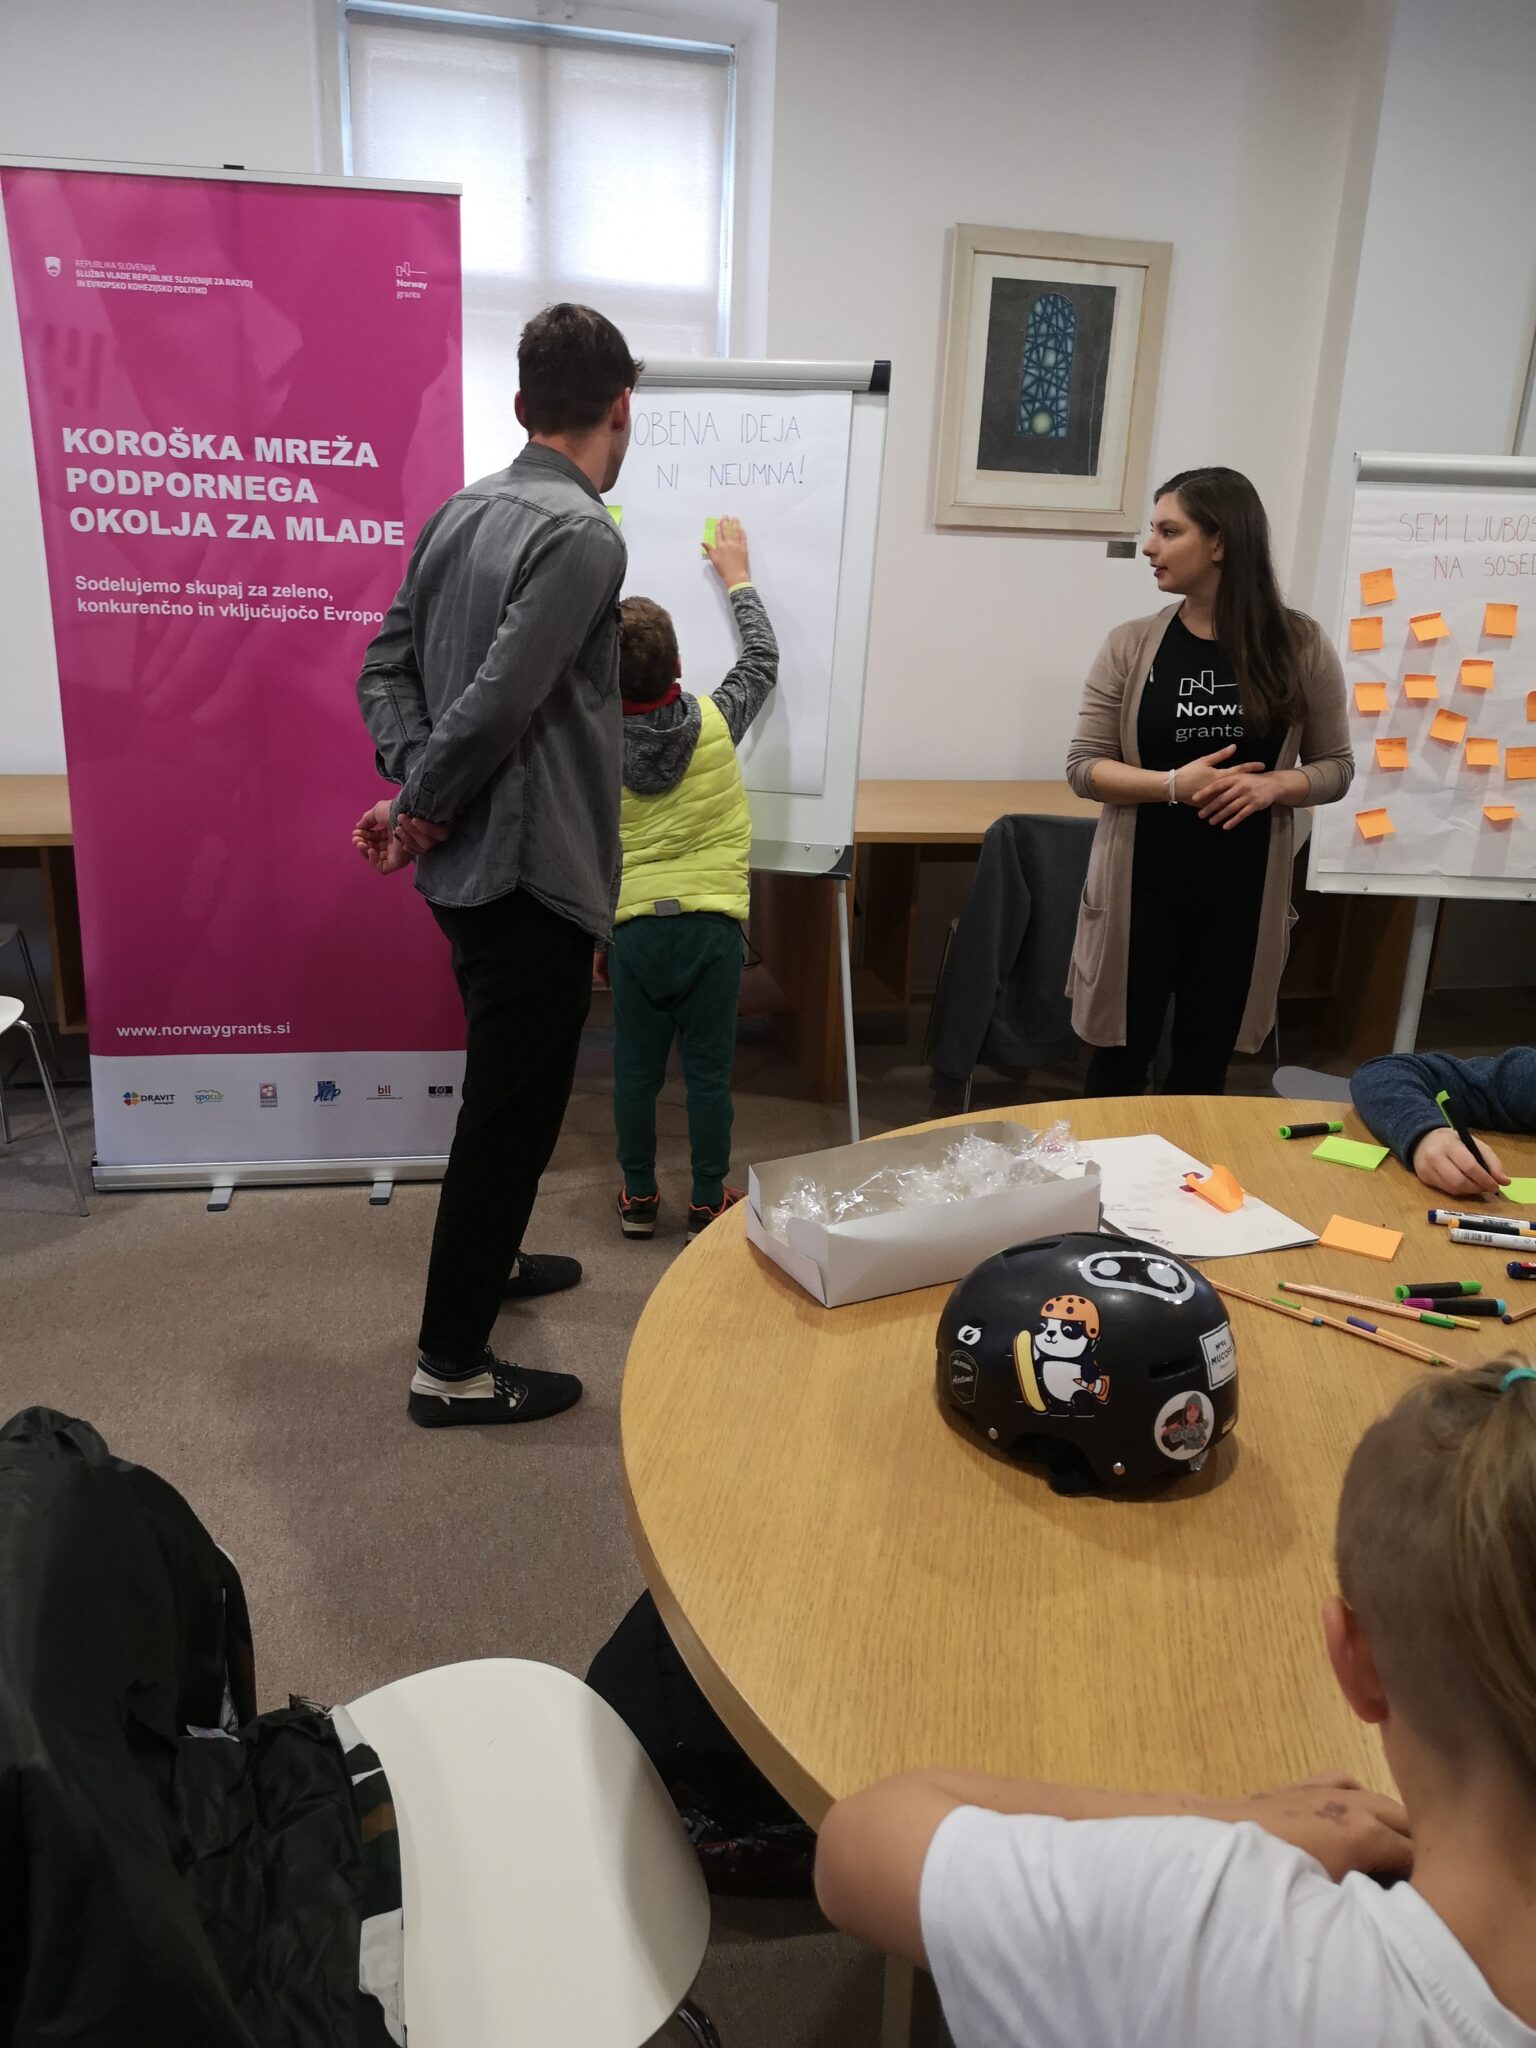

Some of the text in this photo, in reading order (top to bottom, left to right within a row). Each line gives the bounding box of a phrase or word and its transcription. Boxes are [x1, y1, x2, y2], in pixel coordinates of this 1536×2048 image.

[75, 260, 156, 272] REPUBLIKA SLOVENIJA
[76, 269, 253, 288] SLUŽBA VLADE REPUBLIKE SLOVENIJE ZA RAZVOJ
[76, 280, 208, 294] IN EVROPSKO KOHEZIJSKO POLITIKO
[396, 279, 428, 290] Norway
[396, 291, 421, 300] grants
[634, 411, 801, 446] OBENA IDEJA
[62, 427, 379, 468] KOROŠKA MREŽA
[657, 455, 806, 490] NI NEUMNA!
[66, 468, 318, 503] PODPORNEGA
[70, 507, 405, 546] OKOLJA ZA MLADE
[1396, 513, 1448, 542] SEM
[1434, 555, 1464, 580] NA
[75, 576, 334, 601] Sodelujemo skupaj za zeleno,
[77, 598, 384, 625] konkurenčno in vključujočo Evropo
[1176, 724, 1244, 742] grants
[116, 1022, 290, 1038] www.norwaygrants.si
[140, 1094, 176, 1102] DRAVIT
